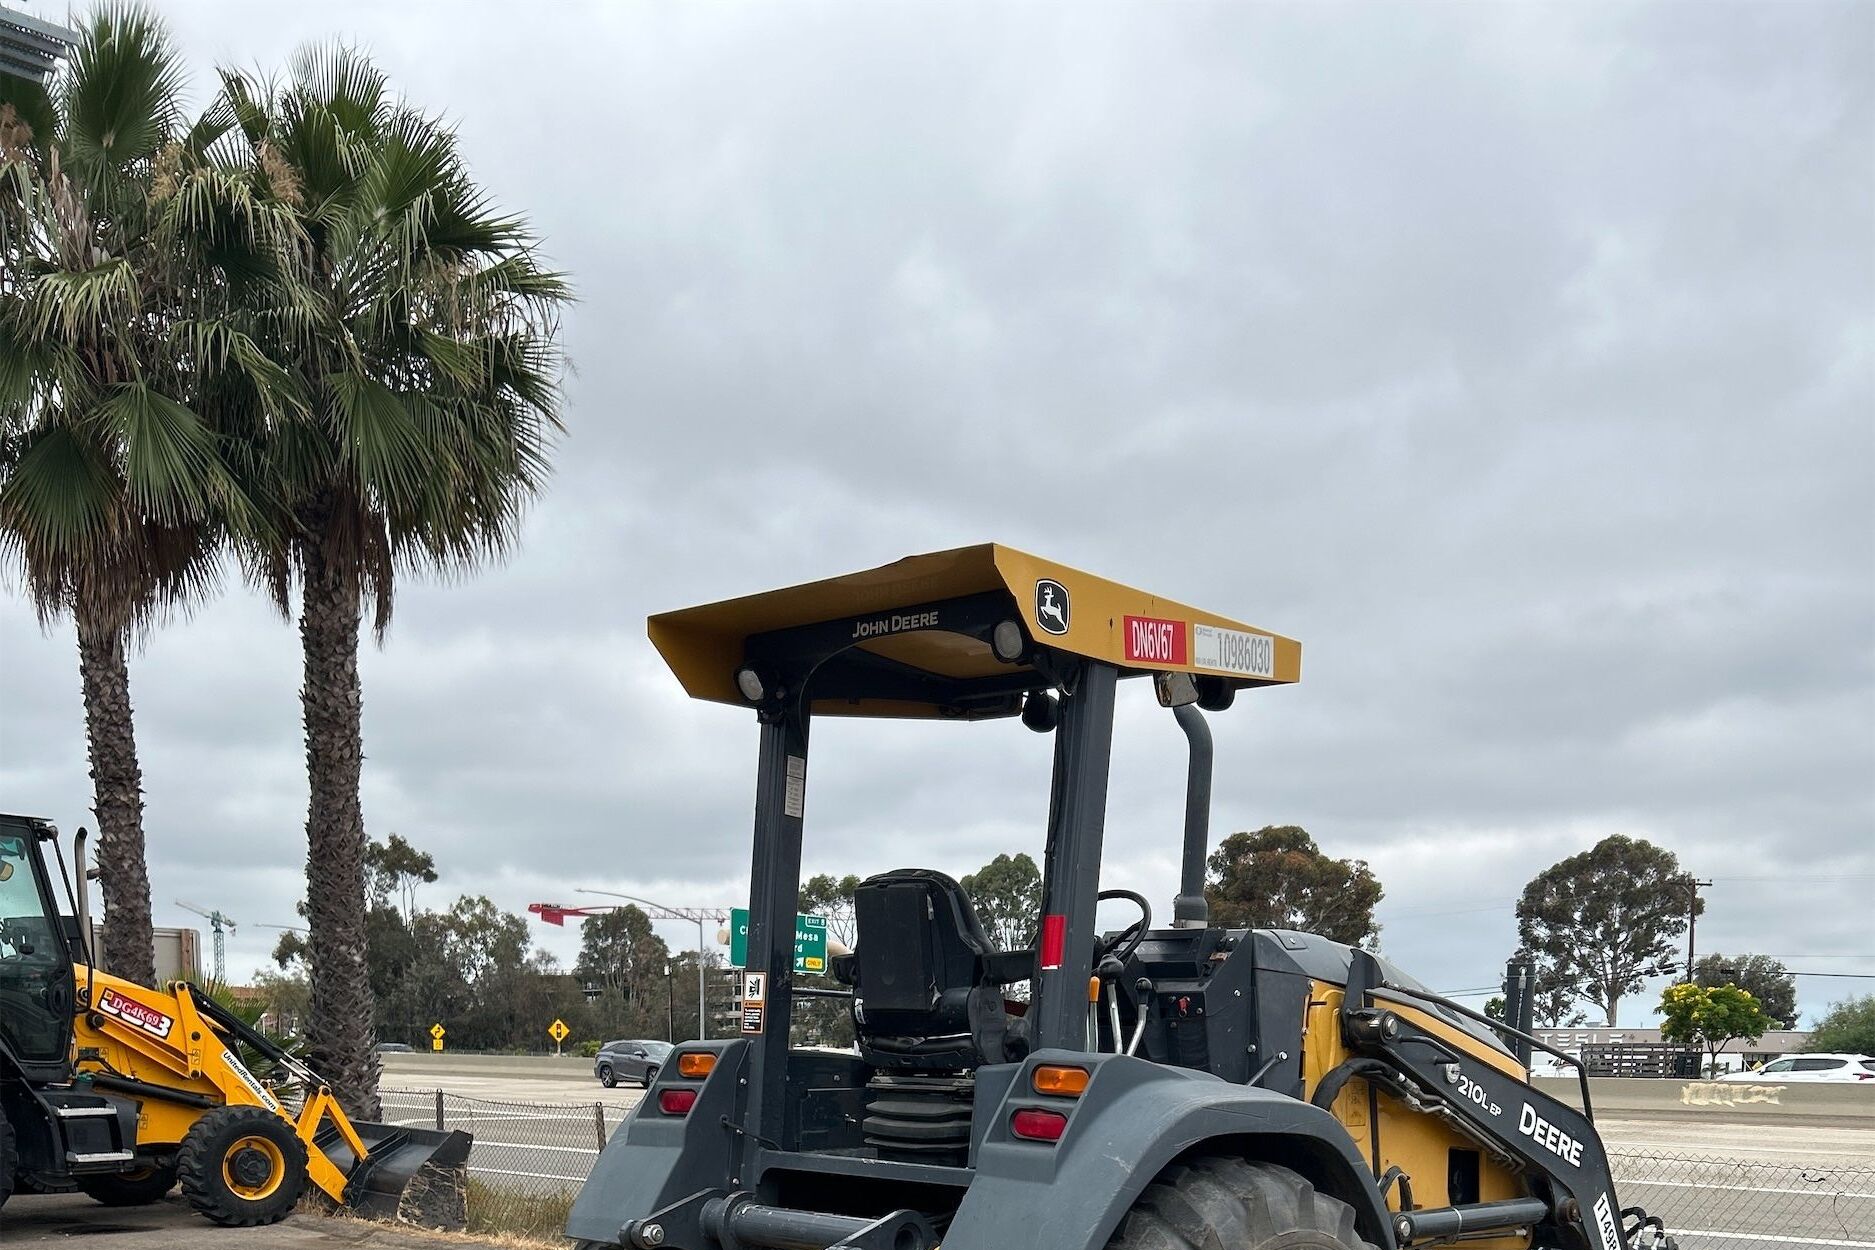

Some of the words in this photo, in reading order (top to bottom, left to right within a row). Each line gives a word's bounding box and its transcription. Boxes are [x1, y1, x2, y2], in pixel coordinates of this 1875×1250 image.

[852, 621, 888, 638] JOHN
[891, 611, 939, 632] DEERE
[1131, 620, 1174, 660] DN6V67
[1217, 632, 1271, 675] 10986030
[795, 930, 819, 942] Mesa
[113, 998, 160, 1026] DG4K69
[223, 1051, 276, 1110] UnitedRentals.com
[1458, 1075, 1489, 1110] 210L
[1489, 1103, 1502, 1117] EP
[1518, 1102, 1584, 1168] DEERE
